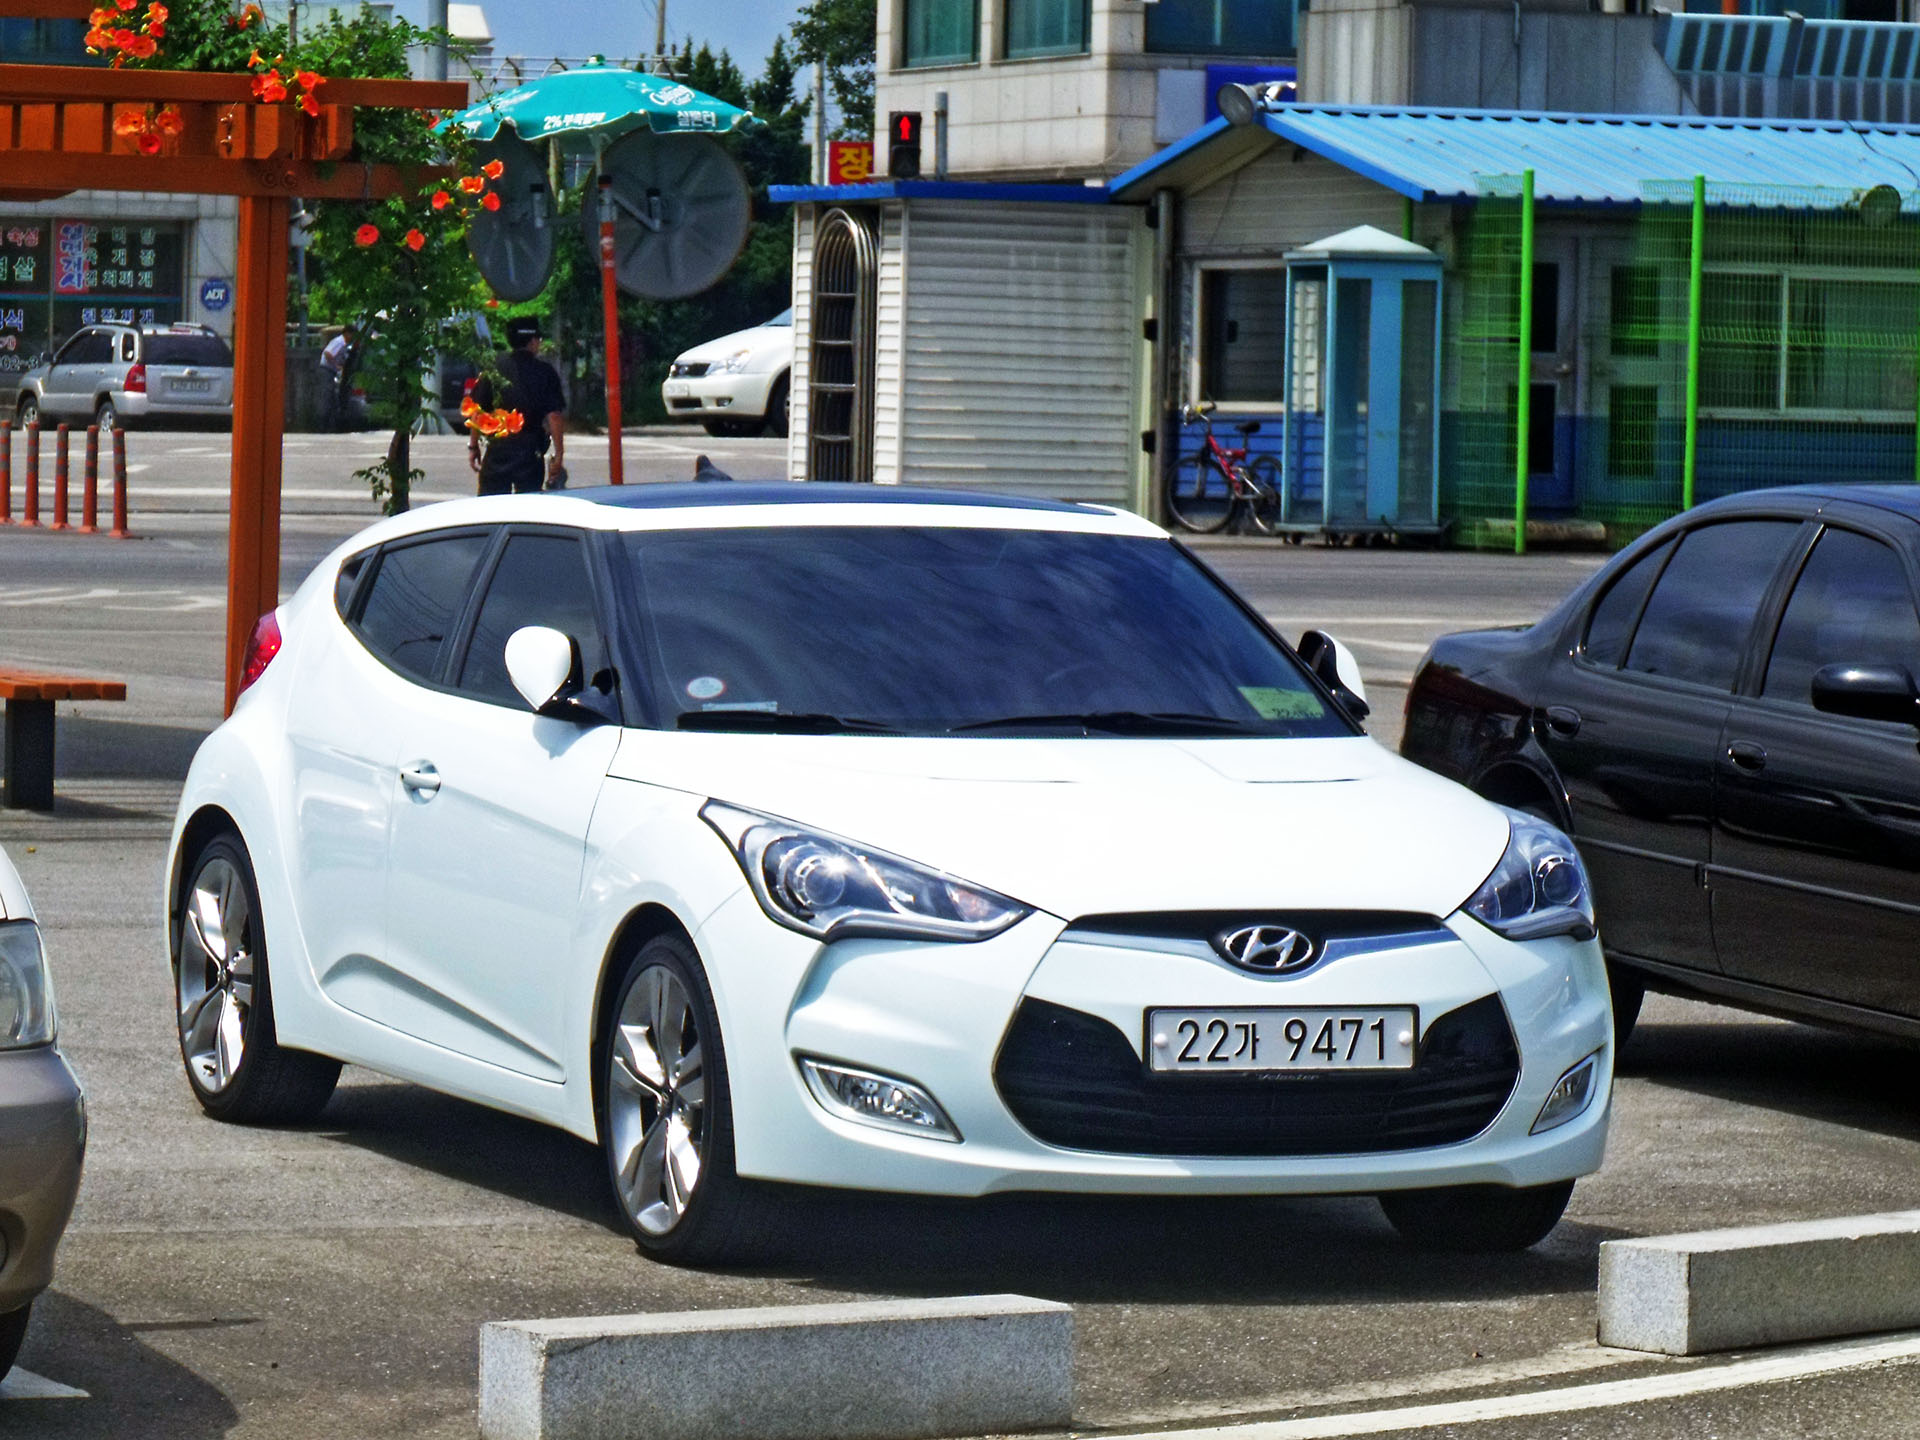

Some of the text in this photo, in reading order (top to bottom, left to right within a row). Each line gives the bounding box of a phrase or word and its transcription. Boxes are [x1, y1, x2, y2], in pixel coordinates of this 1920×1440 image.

[204, 288, 226, 301] ADT
[1176, 1017, 1385, 1063] 22가 9471
